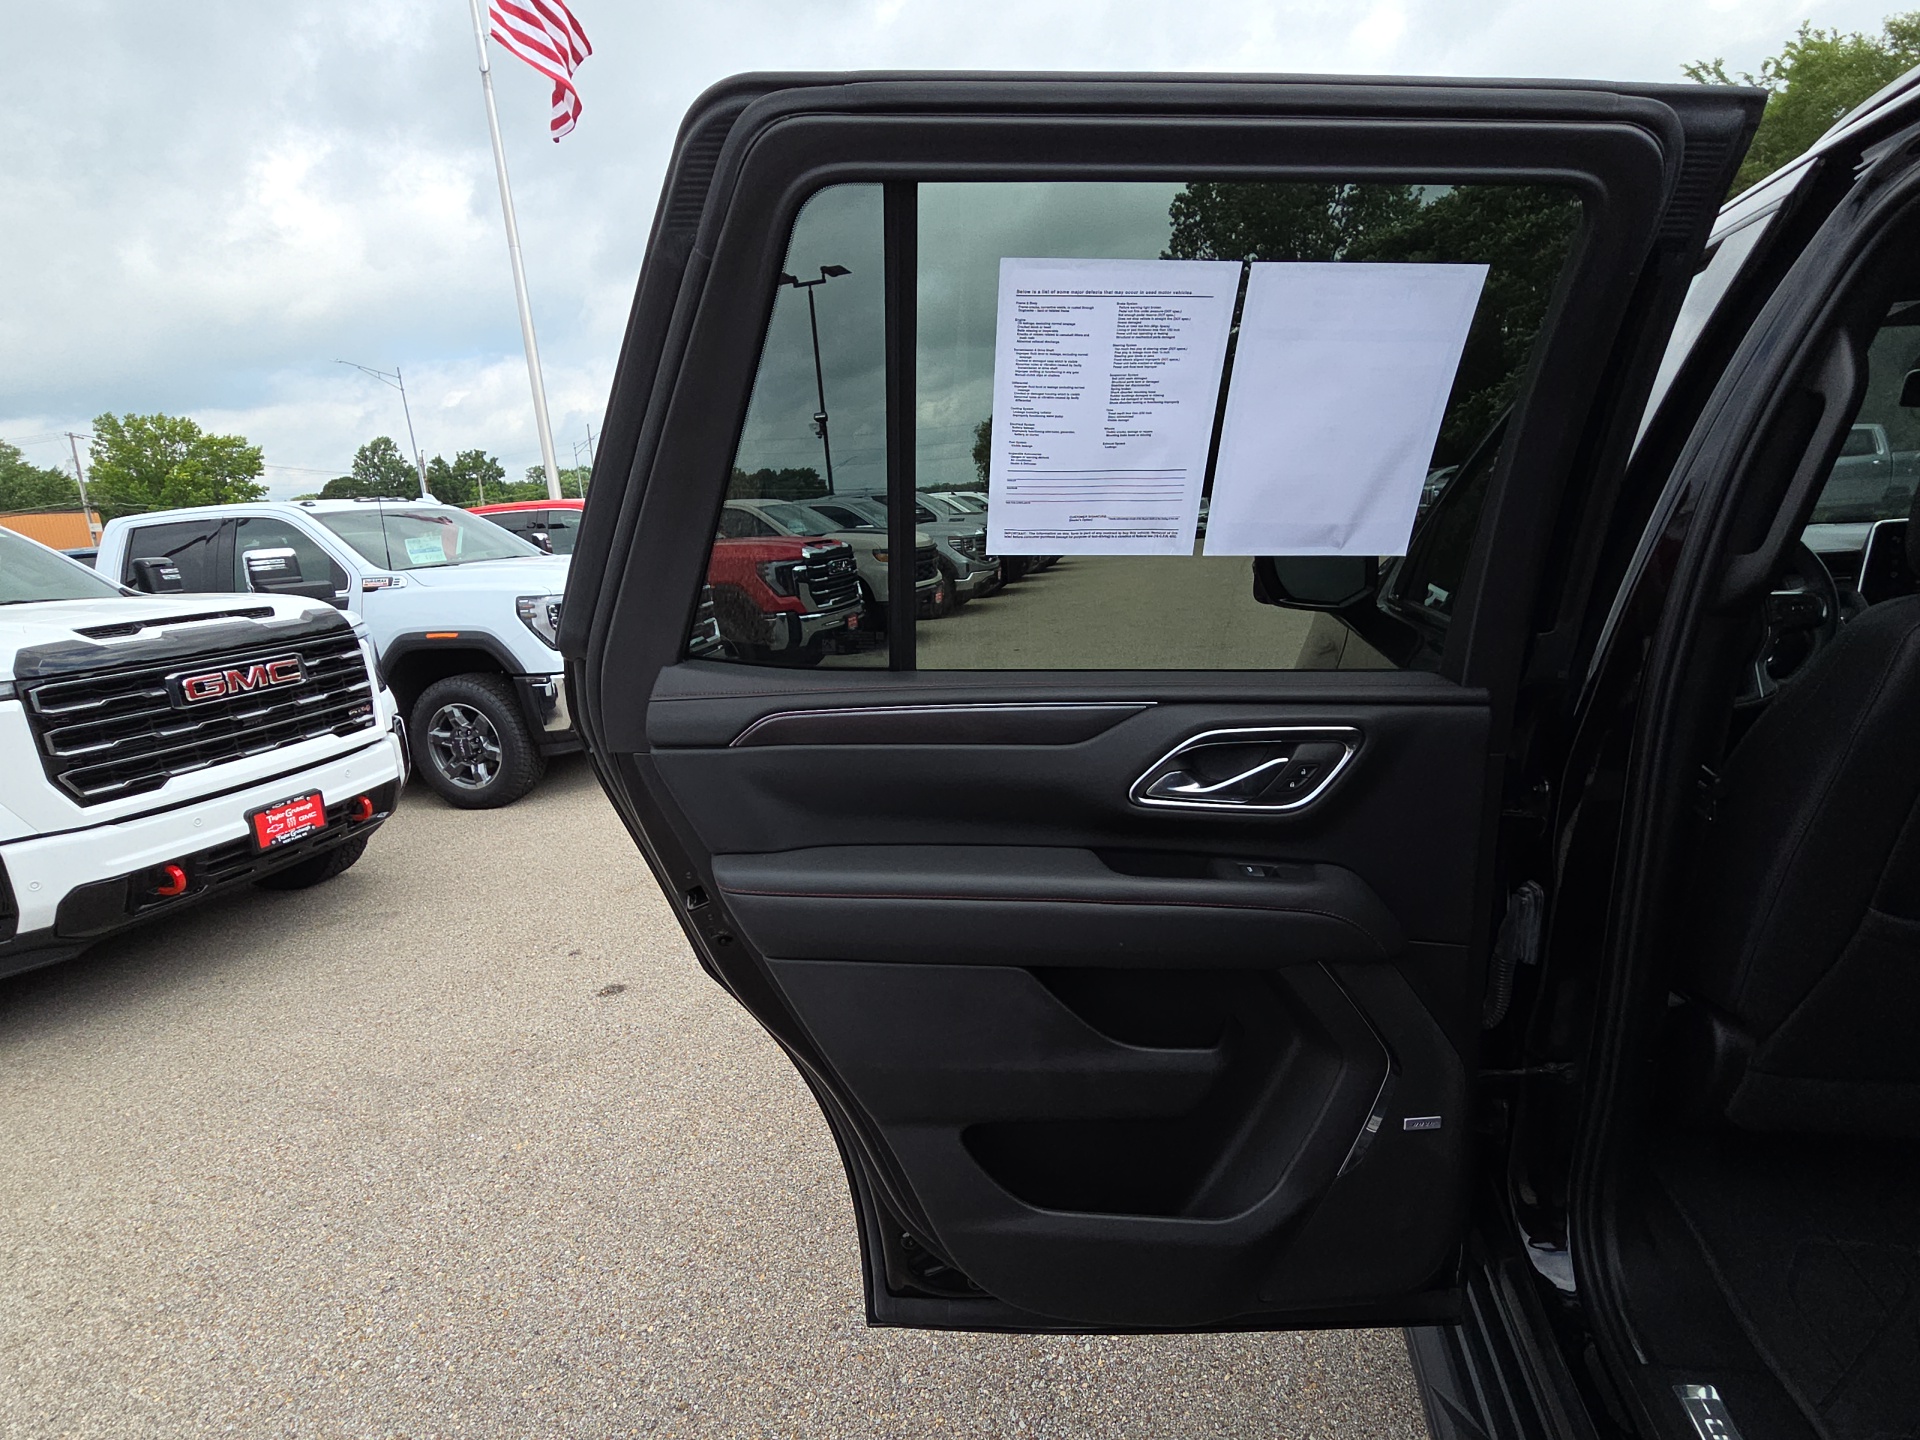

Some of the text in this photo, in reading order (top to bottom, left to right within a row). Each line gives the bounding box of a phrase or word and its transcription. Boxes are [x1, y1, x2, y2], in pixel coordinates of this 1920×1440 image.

[182, 659, 301, 702] GMC
[266, 812, 285, 824] Taylor
[298, 811, 317, 821] GMC
